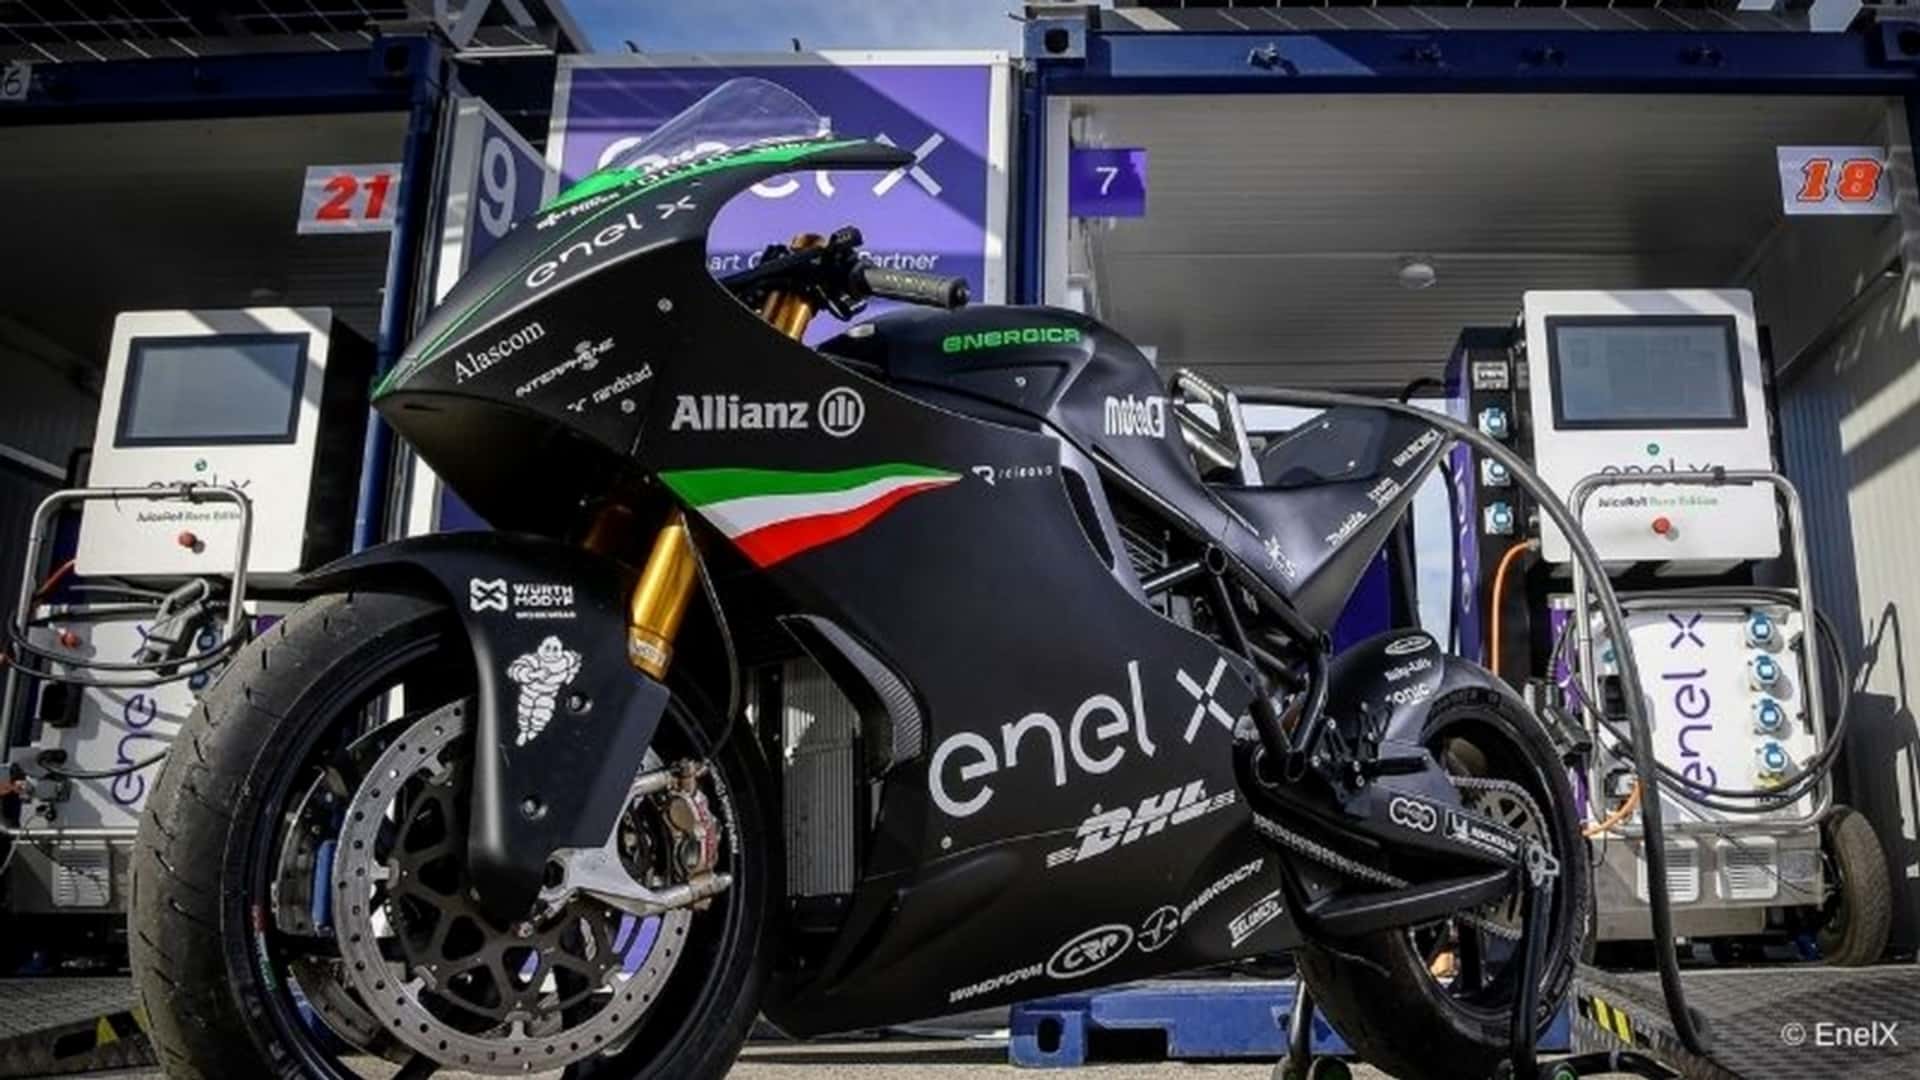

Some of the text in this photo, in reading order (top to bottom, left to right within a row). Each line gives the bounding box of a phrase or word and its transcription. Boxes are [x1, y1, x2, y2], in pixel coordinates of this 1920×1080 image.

[316, 172, 392, 220] 21
[480, 137, 516, 237] 9
[1095, 167, 1119, 195] 7
[1797, 158, 1882, 201] 18
[526, 212, 642, 288] enel
[454, 321, 546, 385] Alascom
[592, 363, 653, 404] randstad
[671, 395, 808, 431] Allianz
[929, 660, 1157, 818] enel
[1662, 669, 1719, 801] enel
[1075, 779, 1211, 863] DHL
[1062, 932, 1120, 969] CRP
